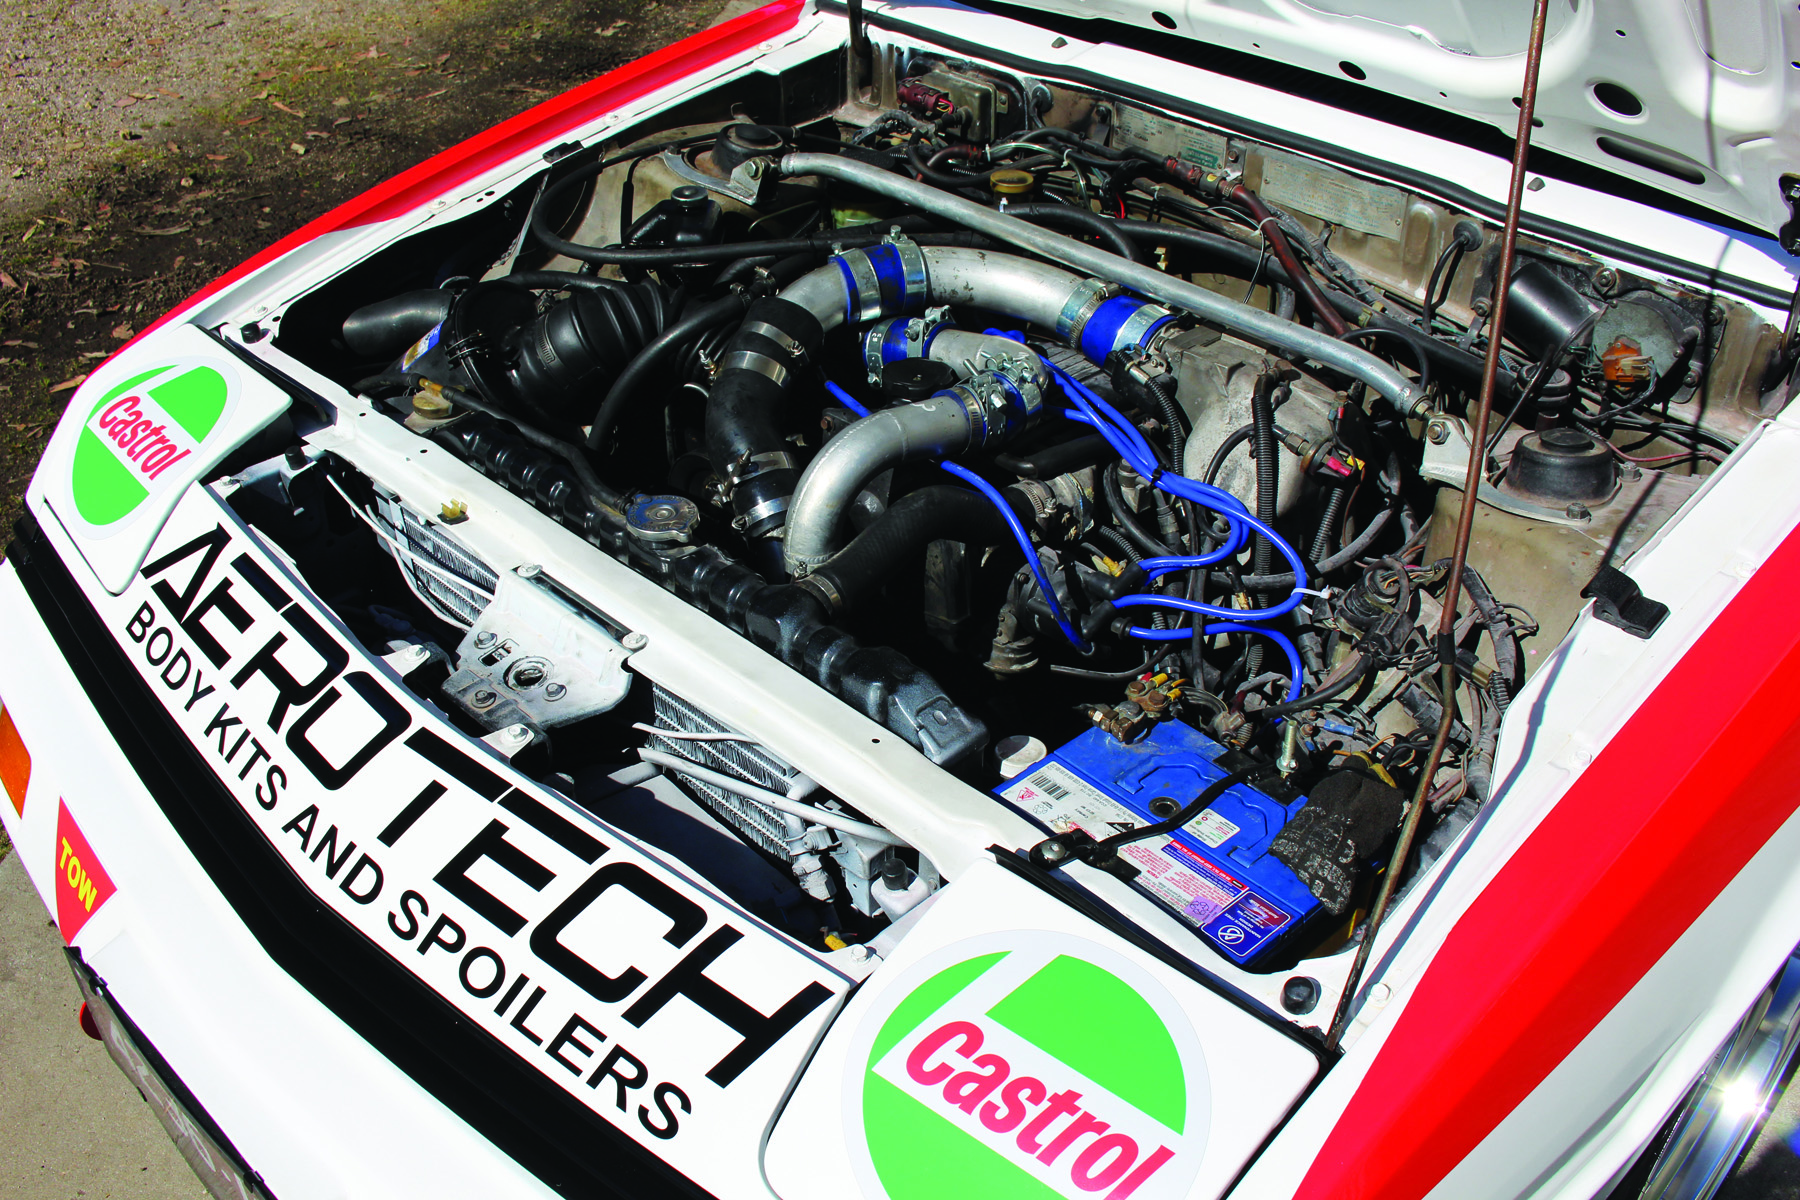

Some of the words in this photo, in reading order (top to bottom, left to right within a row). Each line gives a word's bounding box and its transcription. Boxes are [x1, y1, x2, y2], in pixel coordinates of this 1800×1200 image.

[99, 396, 192, 481] Castrol
[59, 836, 98, 913] TOW
[125, 600, 216, 712] BODY
[203, 702, 287, 811] KITS
[281, 803, 384, 904] AND
[388, 889, 692, 1140] SPOILERS
[140, 522, 835, 1088] AEROTECH
[906, 1020, 1175, 1200] Castrol
